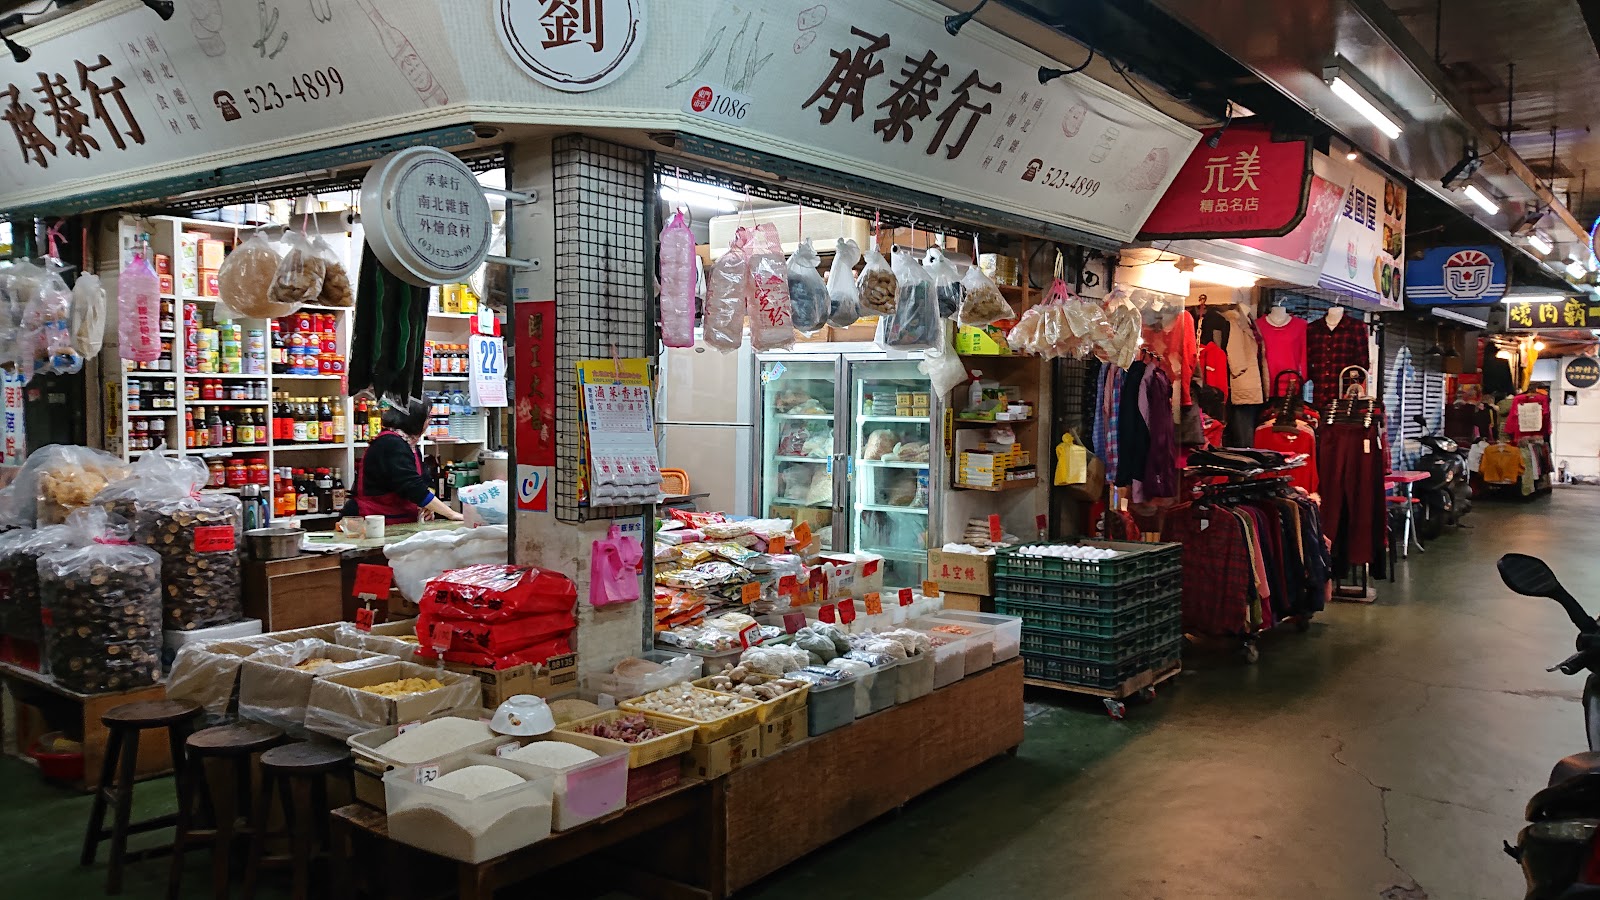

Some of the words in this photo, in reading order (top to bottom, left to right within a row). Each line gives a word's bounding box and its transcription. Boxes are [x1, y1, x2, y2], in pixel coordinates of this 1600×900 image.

[244, 66, 344, 113] 523-4899
[802, 26, 1001, 159] 承泰行
[0, 54, 145, 168] 承泰行
[710, 95, 750, 119] 1086
[425, 173, 461, 191] 承泰行
[1041, 167, 1101, 197] 523-4899
[1201, 145, 1260, 193] 元美
[417, 195, 471, 216] 南北雜貨
[1199, 197, 1259, 213] 精品名店
[419, 217, 471, 239] 外燴食材
[480, 340, 498, 374] 22
[595, 385, 643, 400] 滷菜香料
